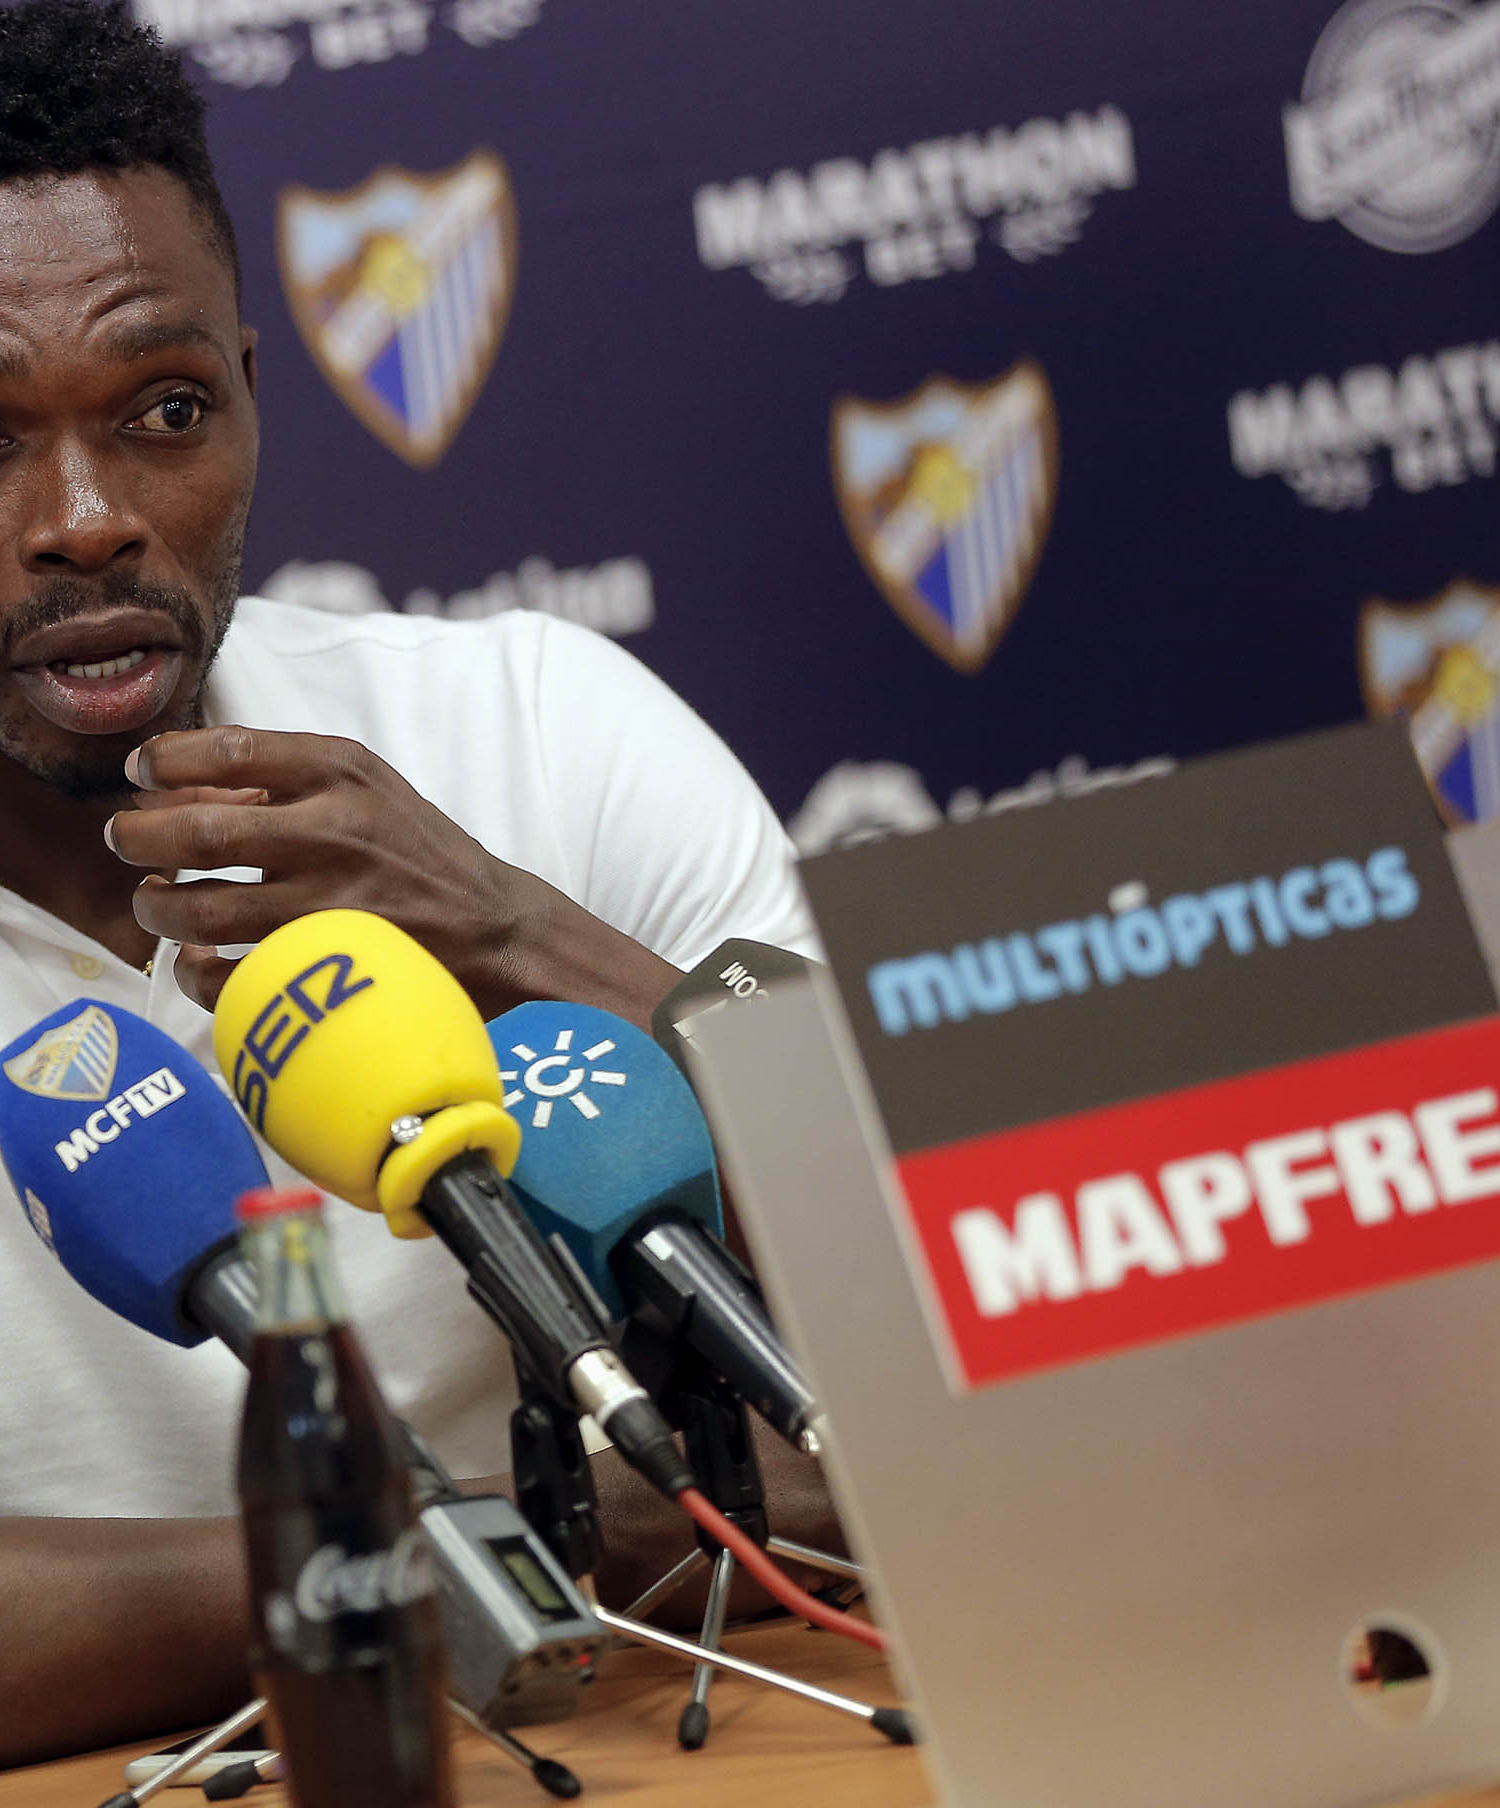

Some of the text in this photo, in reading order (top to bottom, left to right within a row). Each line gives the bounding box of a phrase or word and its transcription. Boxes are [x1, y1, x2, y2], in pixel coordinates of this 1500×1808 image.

[693, 102, 1135, 270] MARATHON
[1393, 427, 1496, 493] BET
[234, 954, 374, 1133] SER
[949, 1086, 1500, 1318] MAPFRE
